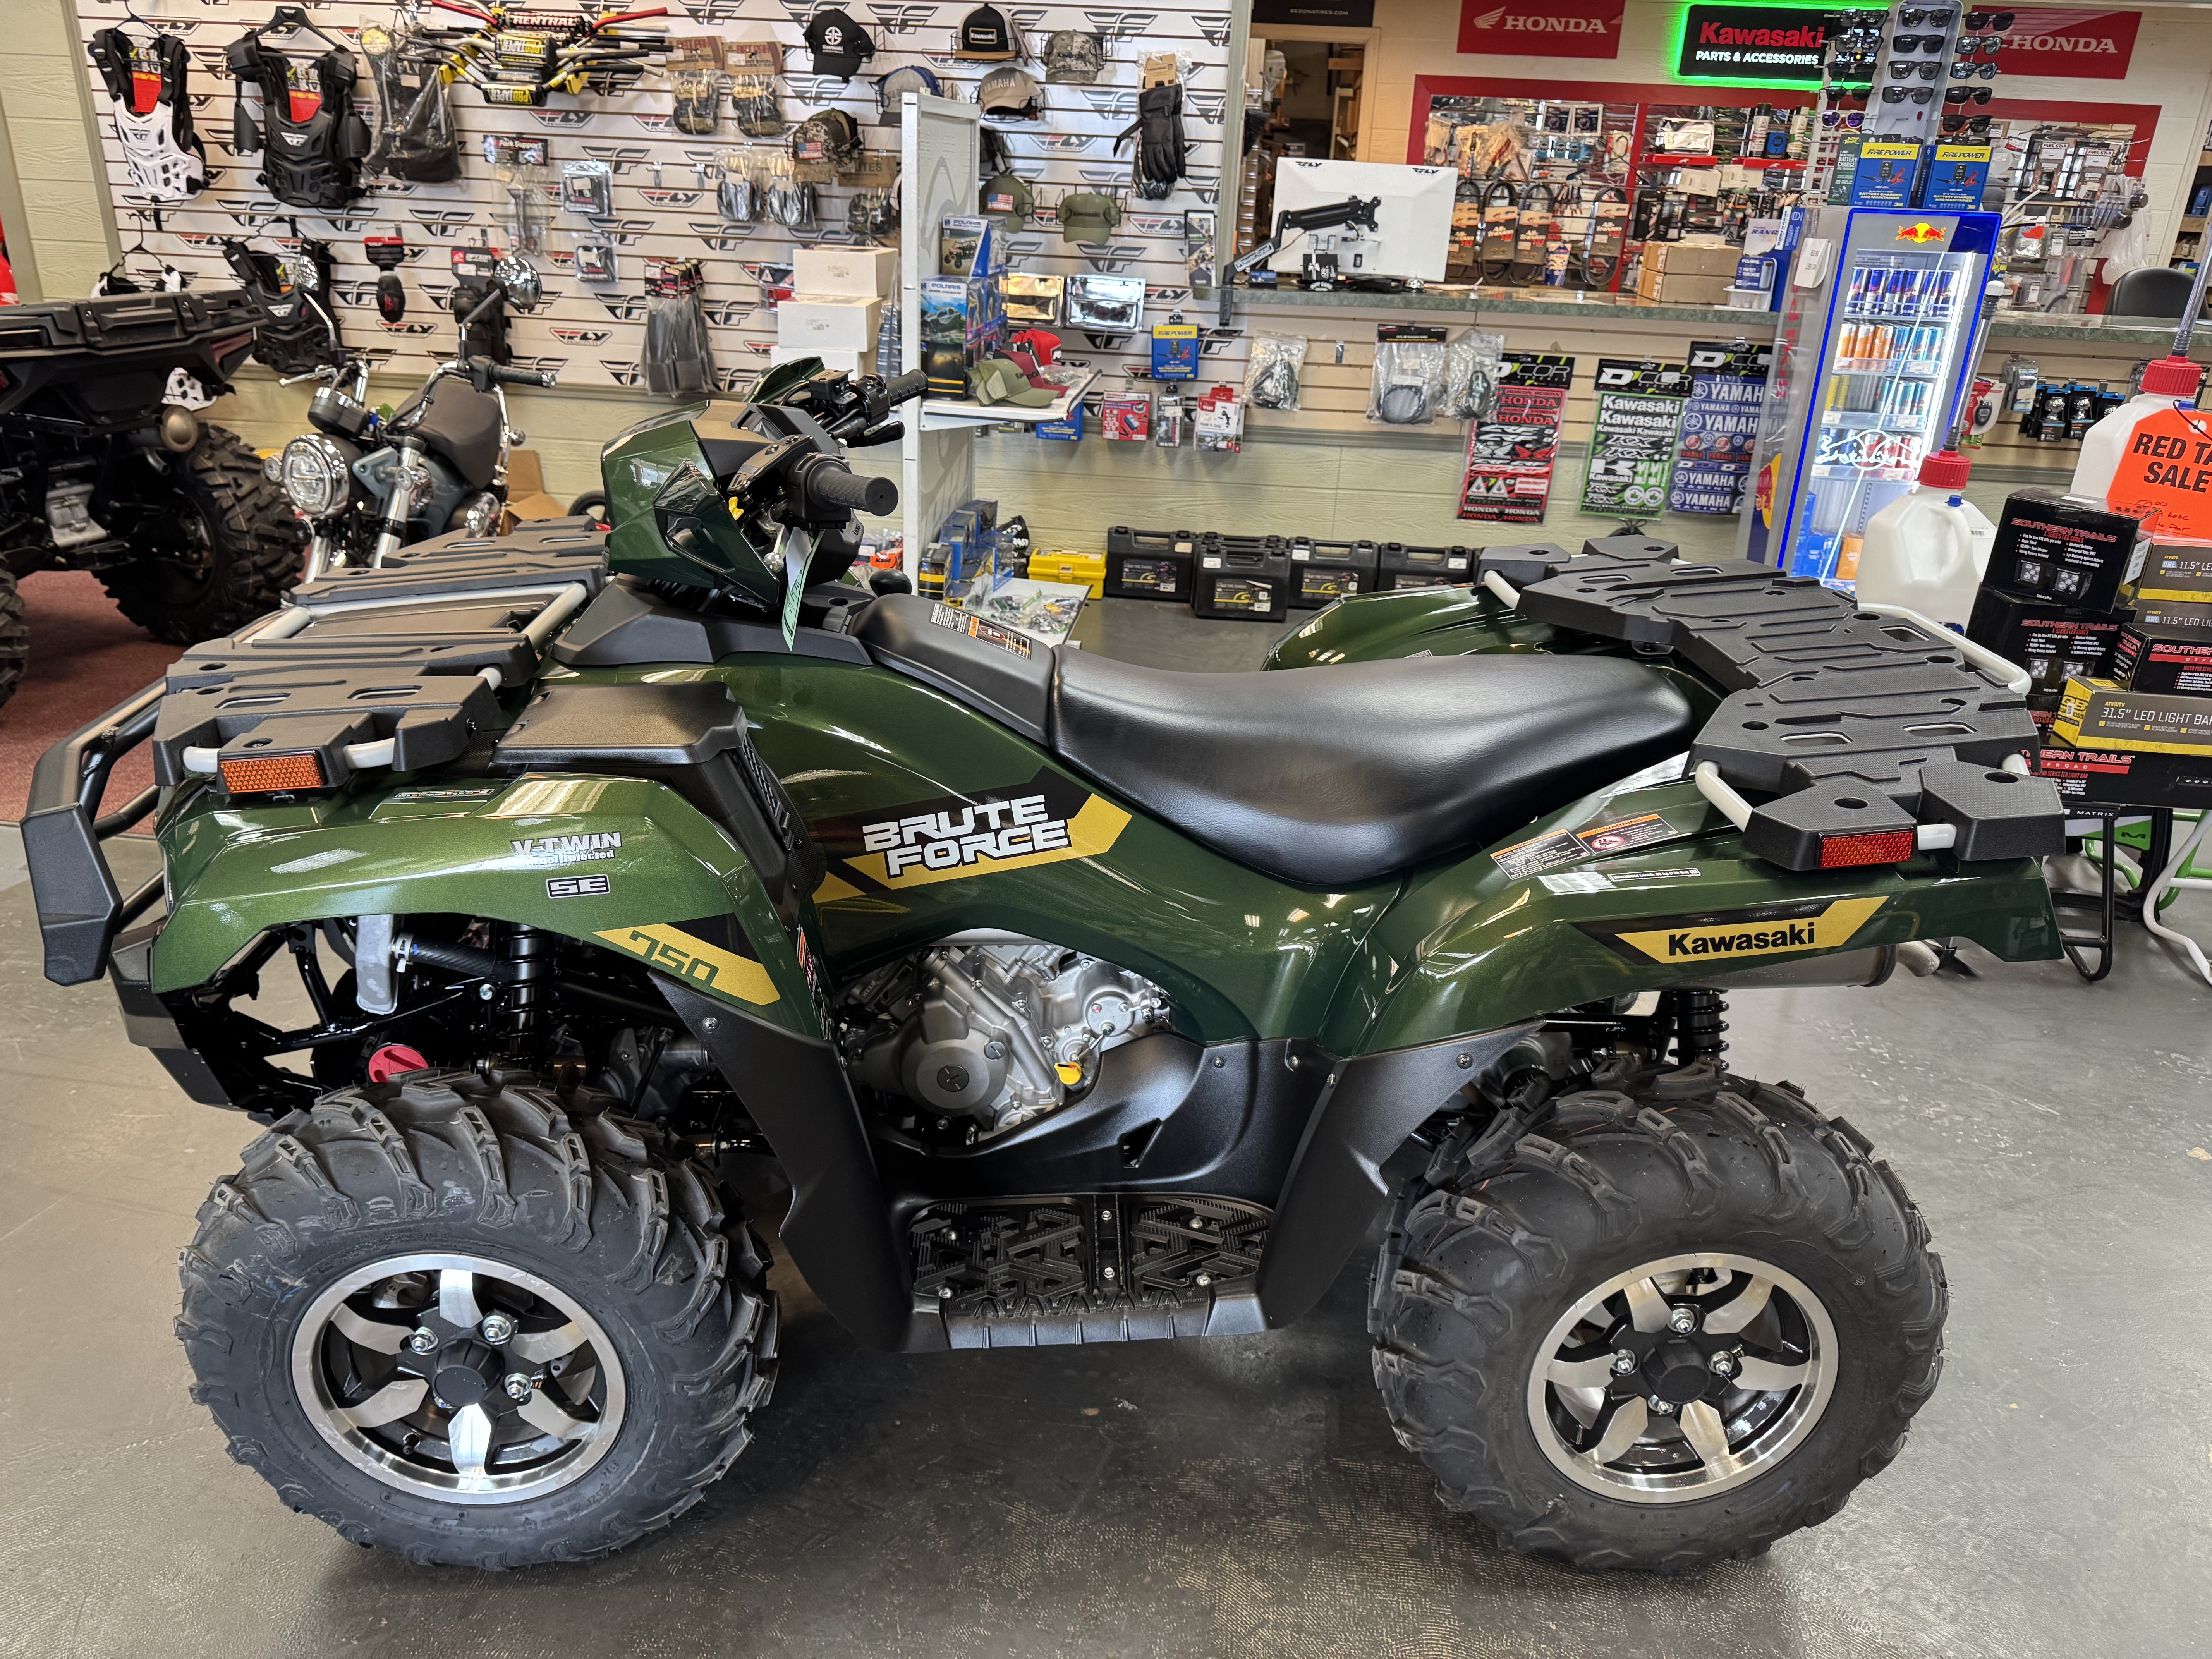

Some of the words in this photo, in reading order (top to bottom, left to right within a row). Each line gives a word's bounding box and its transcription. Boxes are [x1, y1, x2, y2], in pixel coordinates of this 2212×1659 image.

[513, 16, 577, 27] RENTHAL
[1504, 15, 1607, 34] HONDA
[1699, 22, 1824, 48] Kawasaki
[2009, 35, 2118, 53] HONDA
[1696, 50, 1731, 61] PARTS
[1733, 52, 1741, 62] &
[1743, 53, 1819, 65] ACCESSORIES
[1710, 383, 1765, 403] YAMAH
[1501, 396, 1558, 407] HONDA
[1602, 395, 1681, 414] Kawasaki
[1700, 403, 1730, 412] YAMAHA
[1741, 405, 1760, 414] YAMA
[1498, 414, 1555, 426] HONDA
[1599, 410, 1677, 429] Kawasaki
[1704, 414, 1759, 434] YAMAH
[1597, 424, 1636, 434] Kawasaki
[1637, 427, 1676, 437] Kawasaki
[2133, 433, 2187, 460] RED
[1589, 472, 1633, 483] Kawasaki
[1689, 472, 1736, 487] YAMAHA
[2143, 461, 2212, 493] SALE
[1685, 493, 1731, 507] YAMAHA
[2011, 518, 2073, 536] SOUTHERN
[2073, 529, 2118, 543] TRAILS
[2169, 523, 2191, 531] Door
[2047, 532, 2061, 540] SERIES
[2021, 619, 2080, 630] SOUTHERN
[2080, 623, 2119, 631] TRAILS
[2184, 618, 2200, 626] LED
[2133, 709, 2155, 721] LED
[2158, 712, 2192, 724] LIGHT
[2077, 752, 2133, 764] TRAILS
[862, 794, 1049, 852] BRUTE
[1603, 818, 1643, 831] WARNING
[512, 832, 622, 857] V-TWIN
[887, 819, 1069, 876] FORCE
[550, 877, 607, 896] SE
[1668, 922, 1815, 957] Kawasaki
[629, 929, 720, 988] 750
